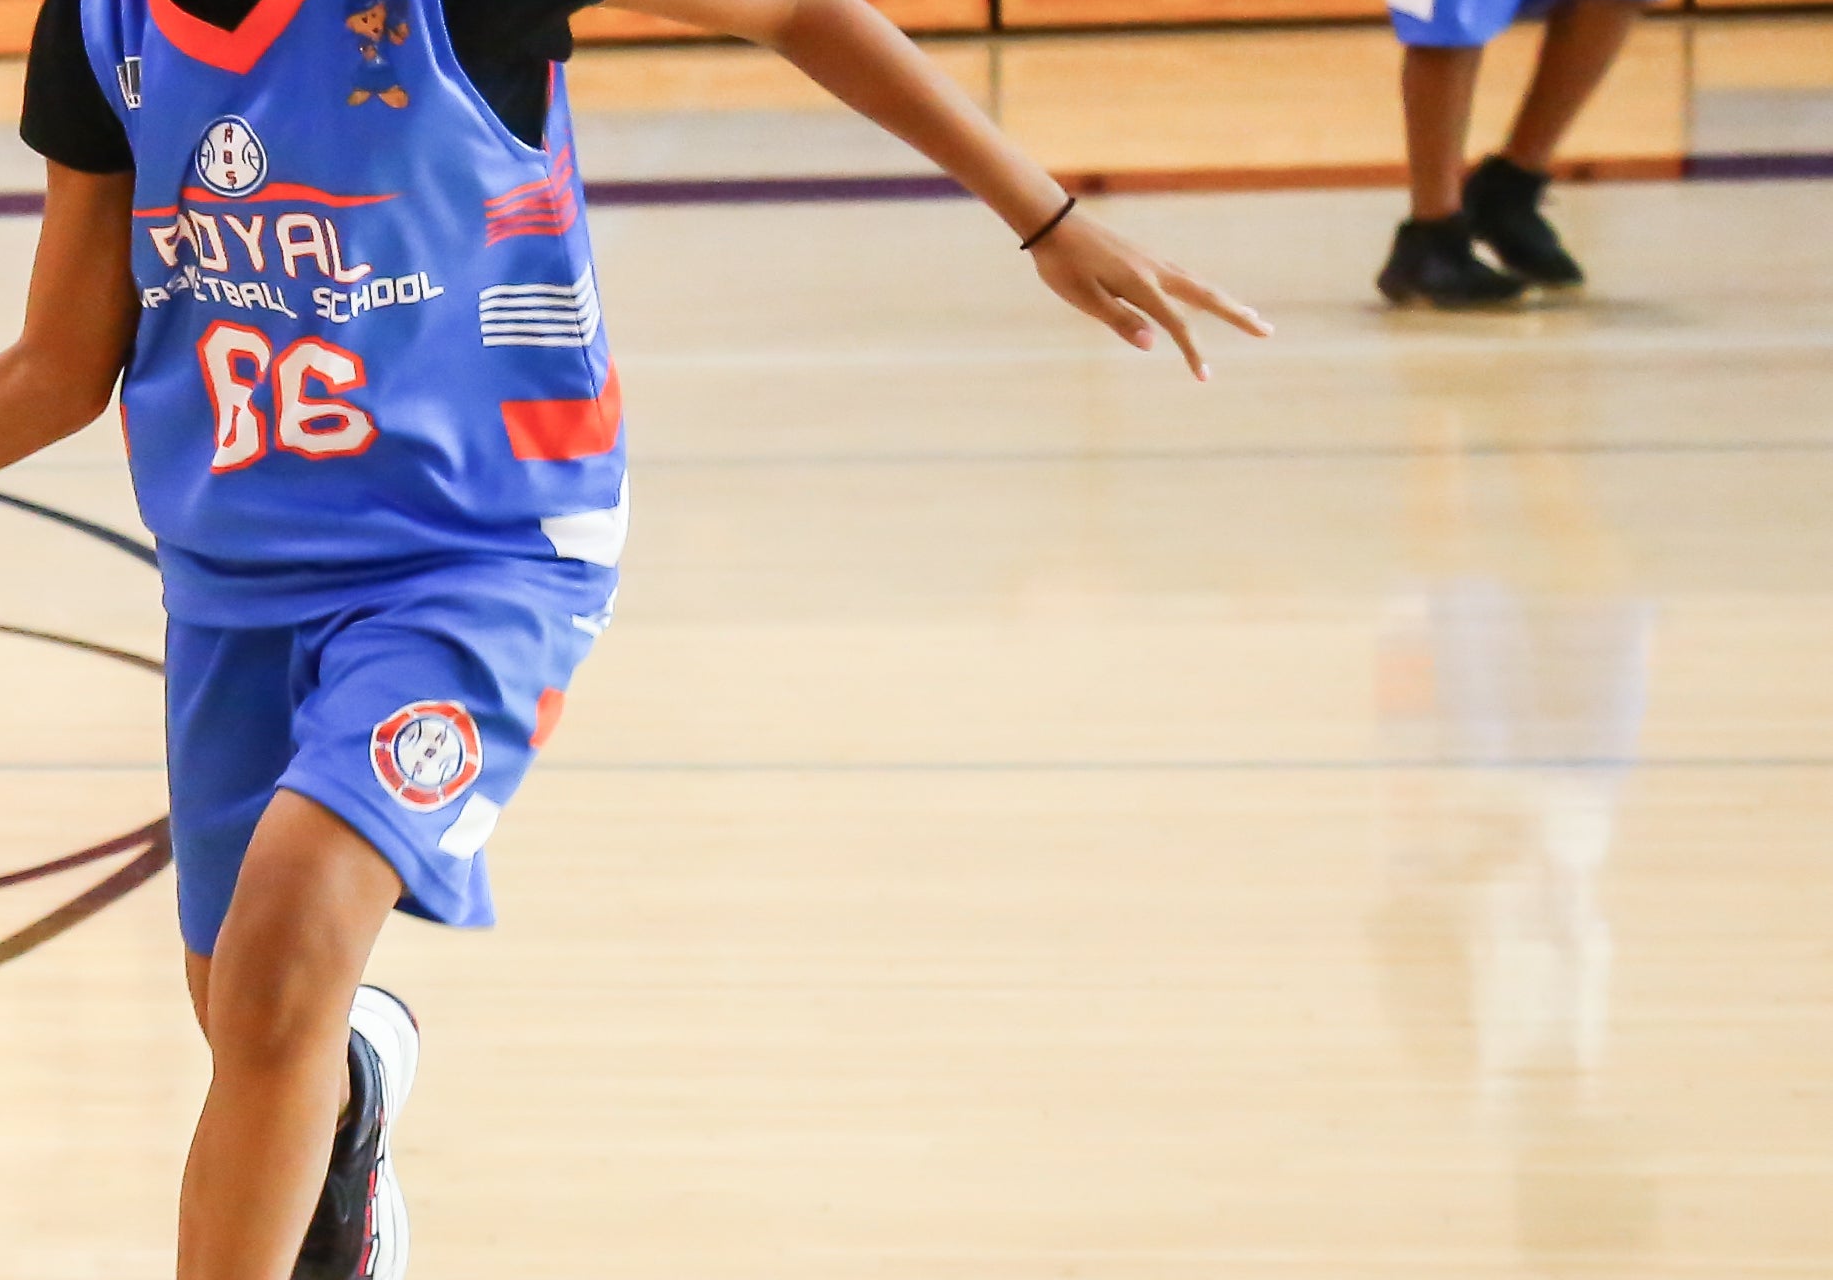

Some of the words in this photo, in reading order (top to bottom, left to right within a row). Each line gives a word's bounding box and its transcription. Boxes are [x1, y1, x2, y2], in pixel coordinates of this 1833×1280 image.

[148, 209, 374, 284] ROYAL
[140, 265, 300, 320] ATBALL
[312, 271, 445, 324] SCHOOL
